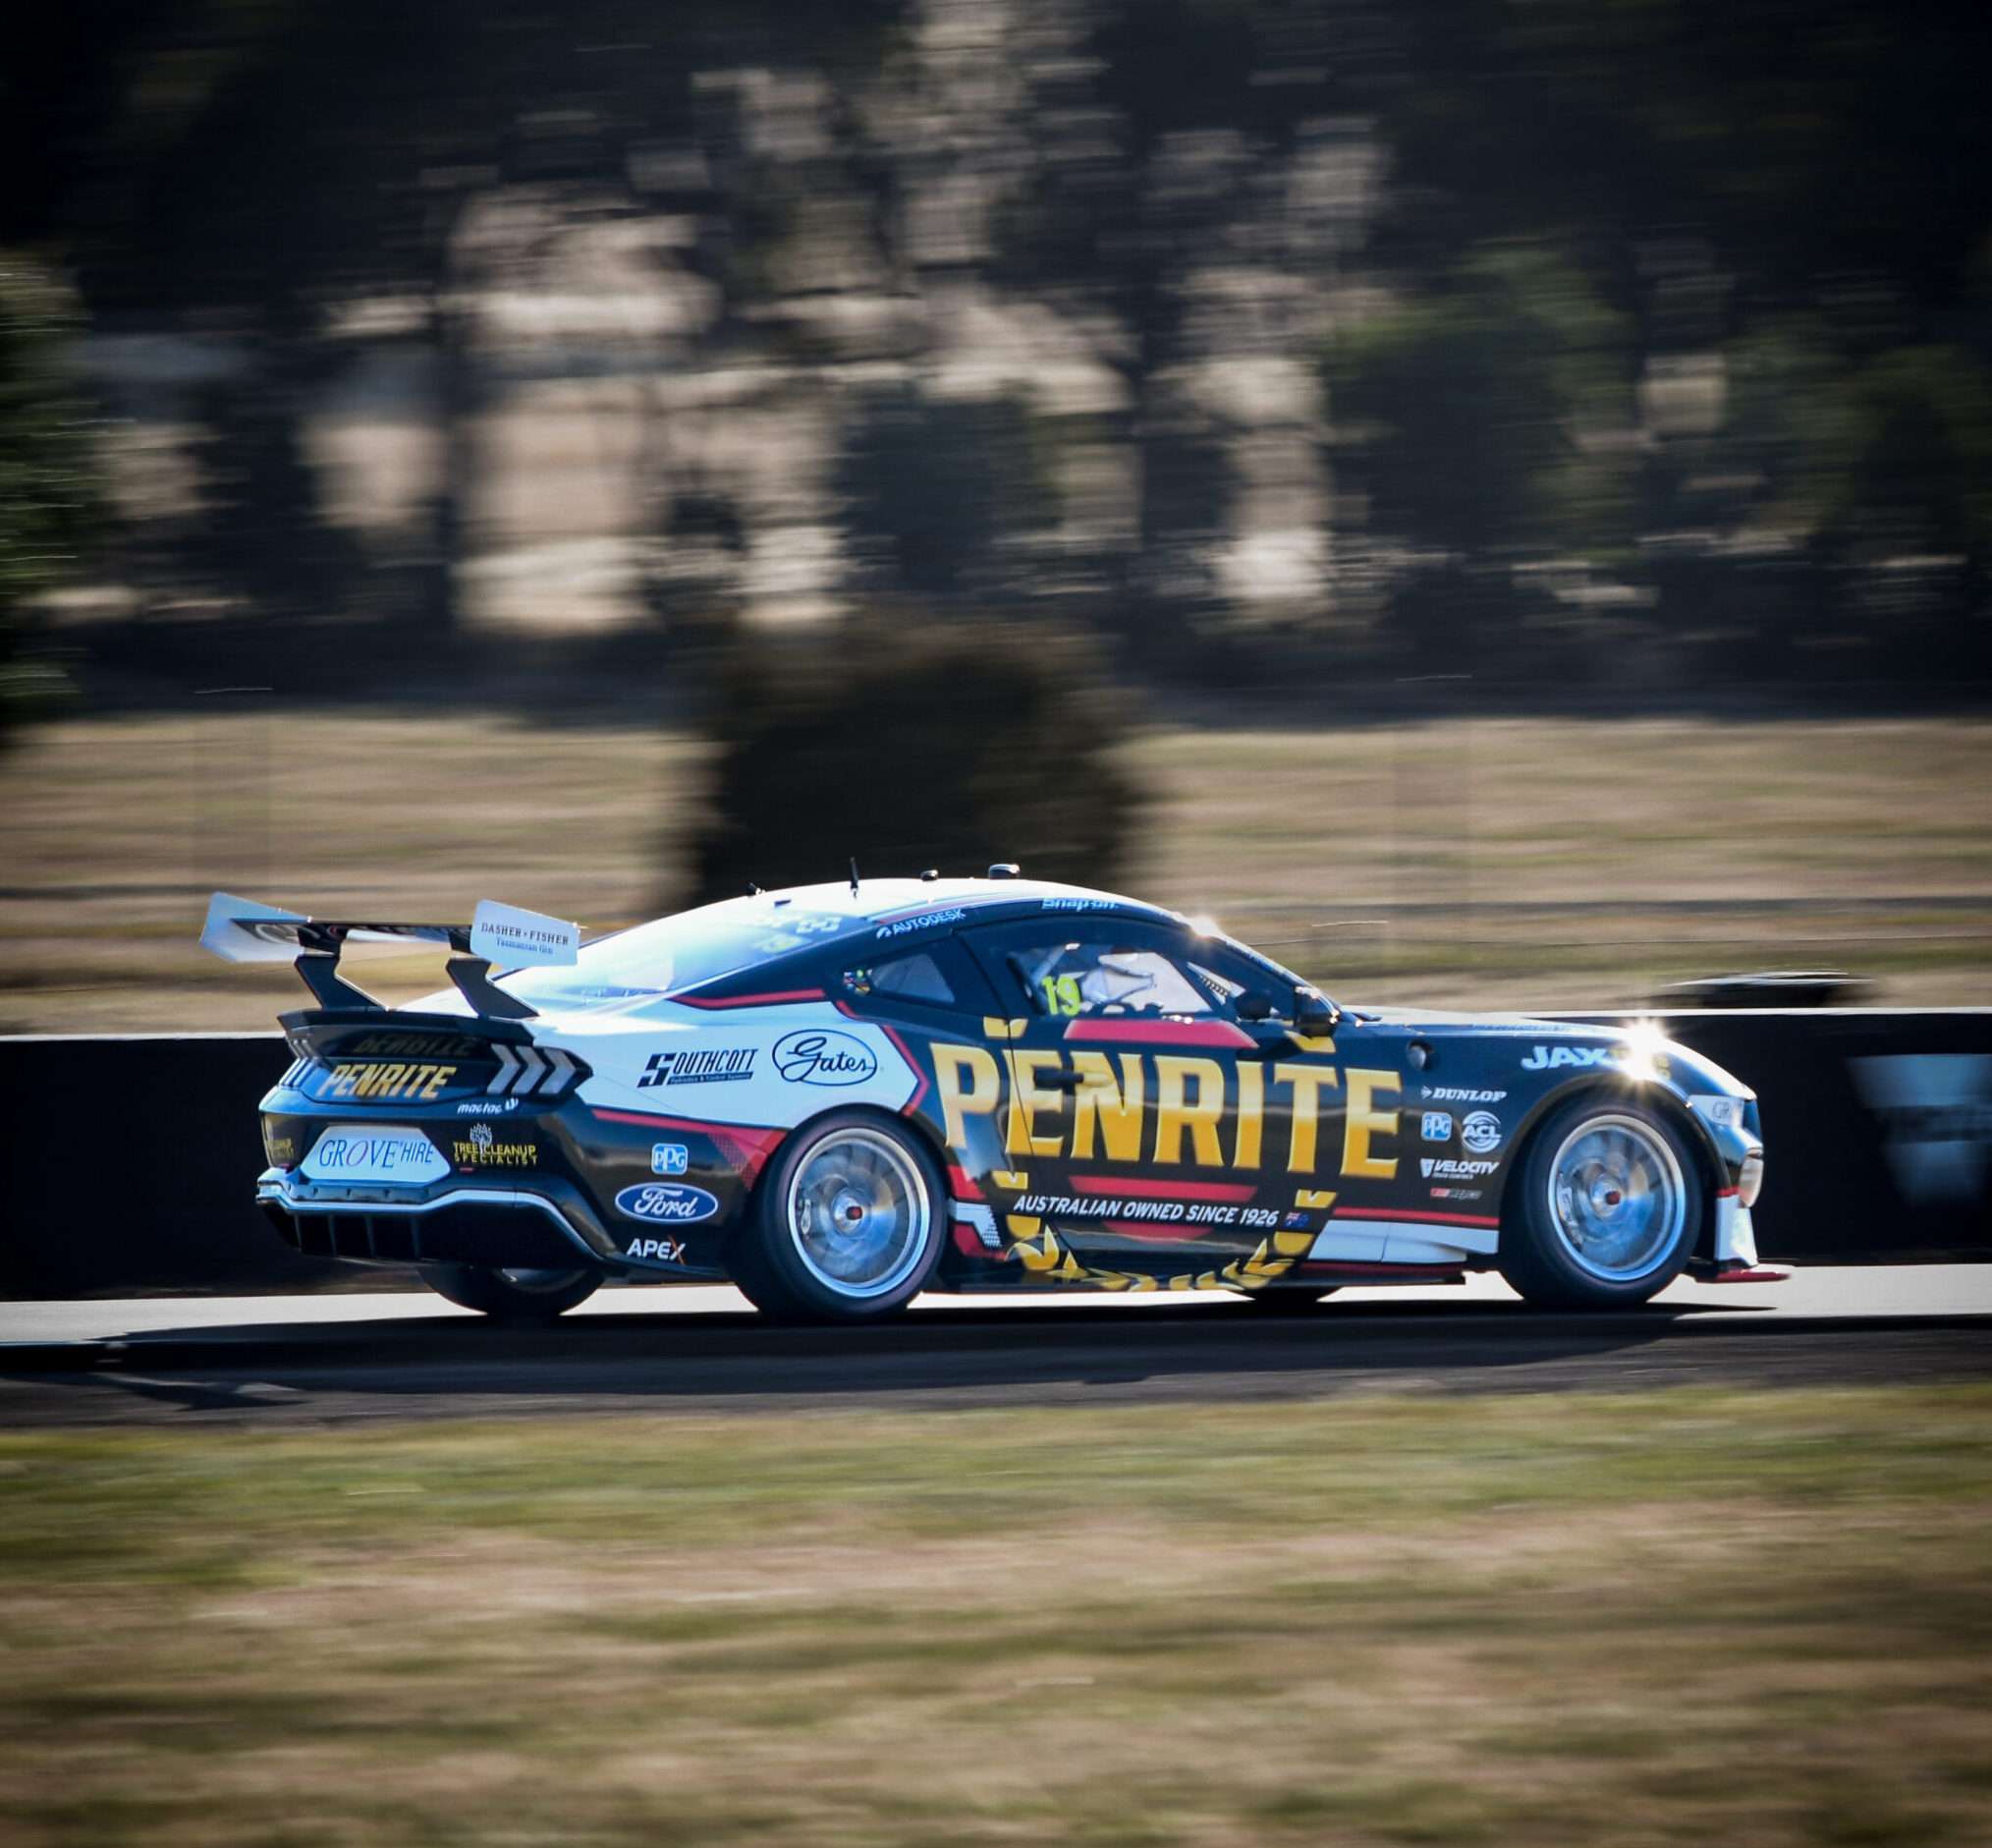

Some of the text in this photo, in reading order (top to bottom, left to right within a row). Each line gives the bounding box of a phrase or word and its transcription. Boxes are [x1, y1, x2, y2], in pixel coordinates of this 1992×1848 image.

[481, 923, 522, 938] DASHER
[529, 930, 570, 945] FISHER
[893, 909, 967, 935] AUTODESK
[1042, 976, 1080, 1016] 19
[636, 1048, 759, 1088] SOUTHCOTT
[781, 1036, 868, 1083] Gates
[1522, 1045, 1607, 1070] JAX
[316, 1064, 457, 1099] PENRITE
[1433, 1088, 1508, 1102] DUNLOP
[930, 1042, 1402, 1179] PENRITE
[1424, 1115, 1451, 1139] PPG
[1463, 1124, 1502, 1139] ACL
[319, 1139, 398, 1168] GROVE
[400, 1141, 434, 1164] HIRE
[453, 1142, 536, 1157] TREE CLEANUP
[454, 1153, 537, 1165] SPECIALIST
[654, 1147, 686, 1172] PPG
[1434, 1159, 1501, 1174] VELOCITY
[634, 1187, 698, 1217] Ford
[1014, 1195, 1280, 1227] AUSTRALIAN OWNED SINCE 1926
[627, 1235, 686, 1264] APEX
